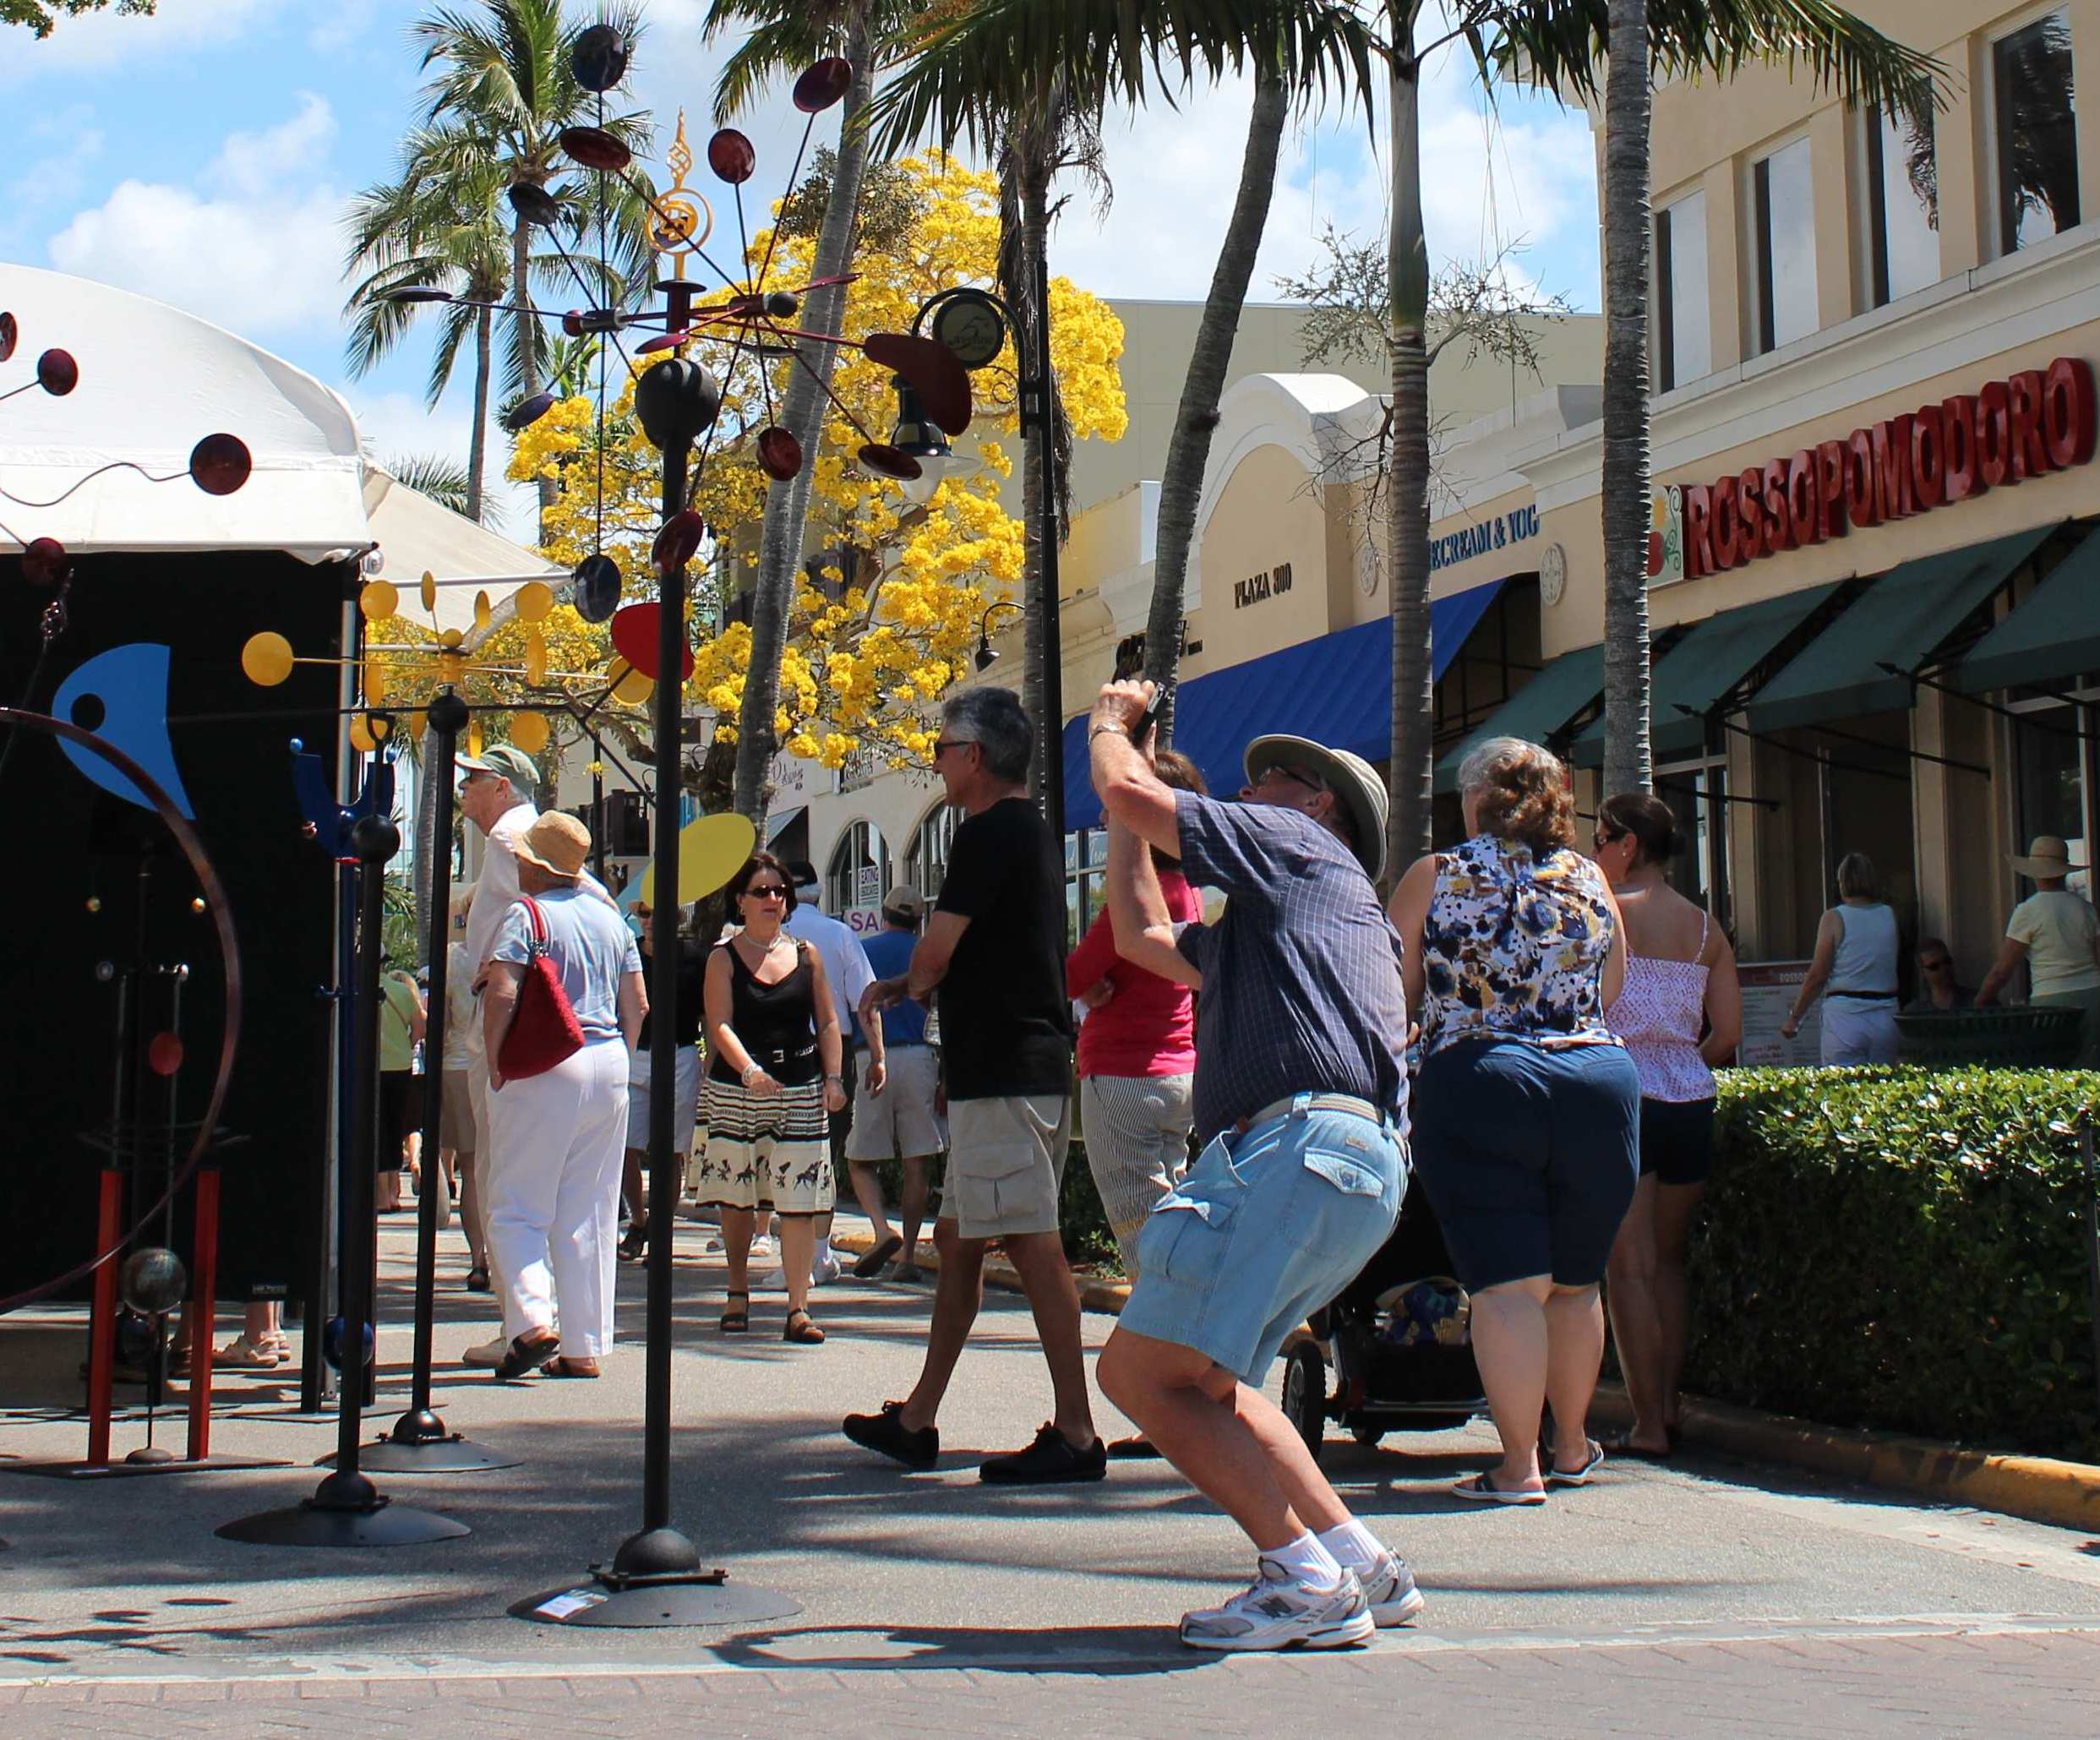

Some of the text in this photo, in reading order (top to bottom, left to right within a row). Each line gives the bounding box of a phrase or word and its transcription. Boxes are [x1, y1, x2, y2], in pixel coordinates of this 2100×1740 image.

[1685, 357, 2097, 580] ROSSOPOMODORO
[1494, 516, 1507, 549] &
[1234, 571, 1271, 609] PLAZA
